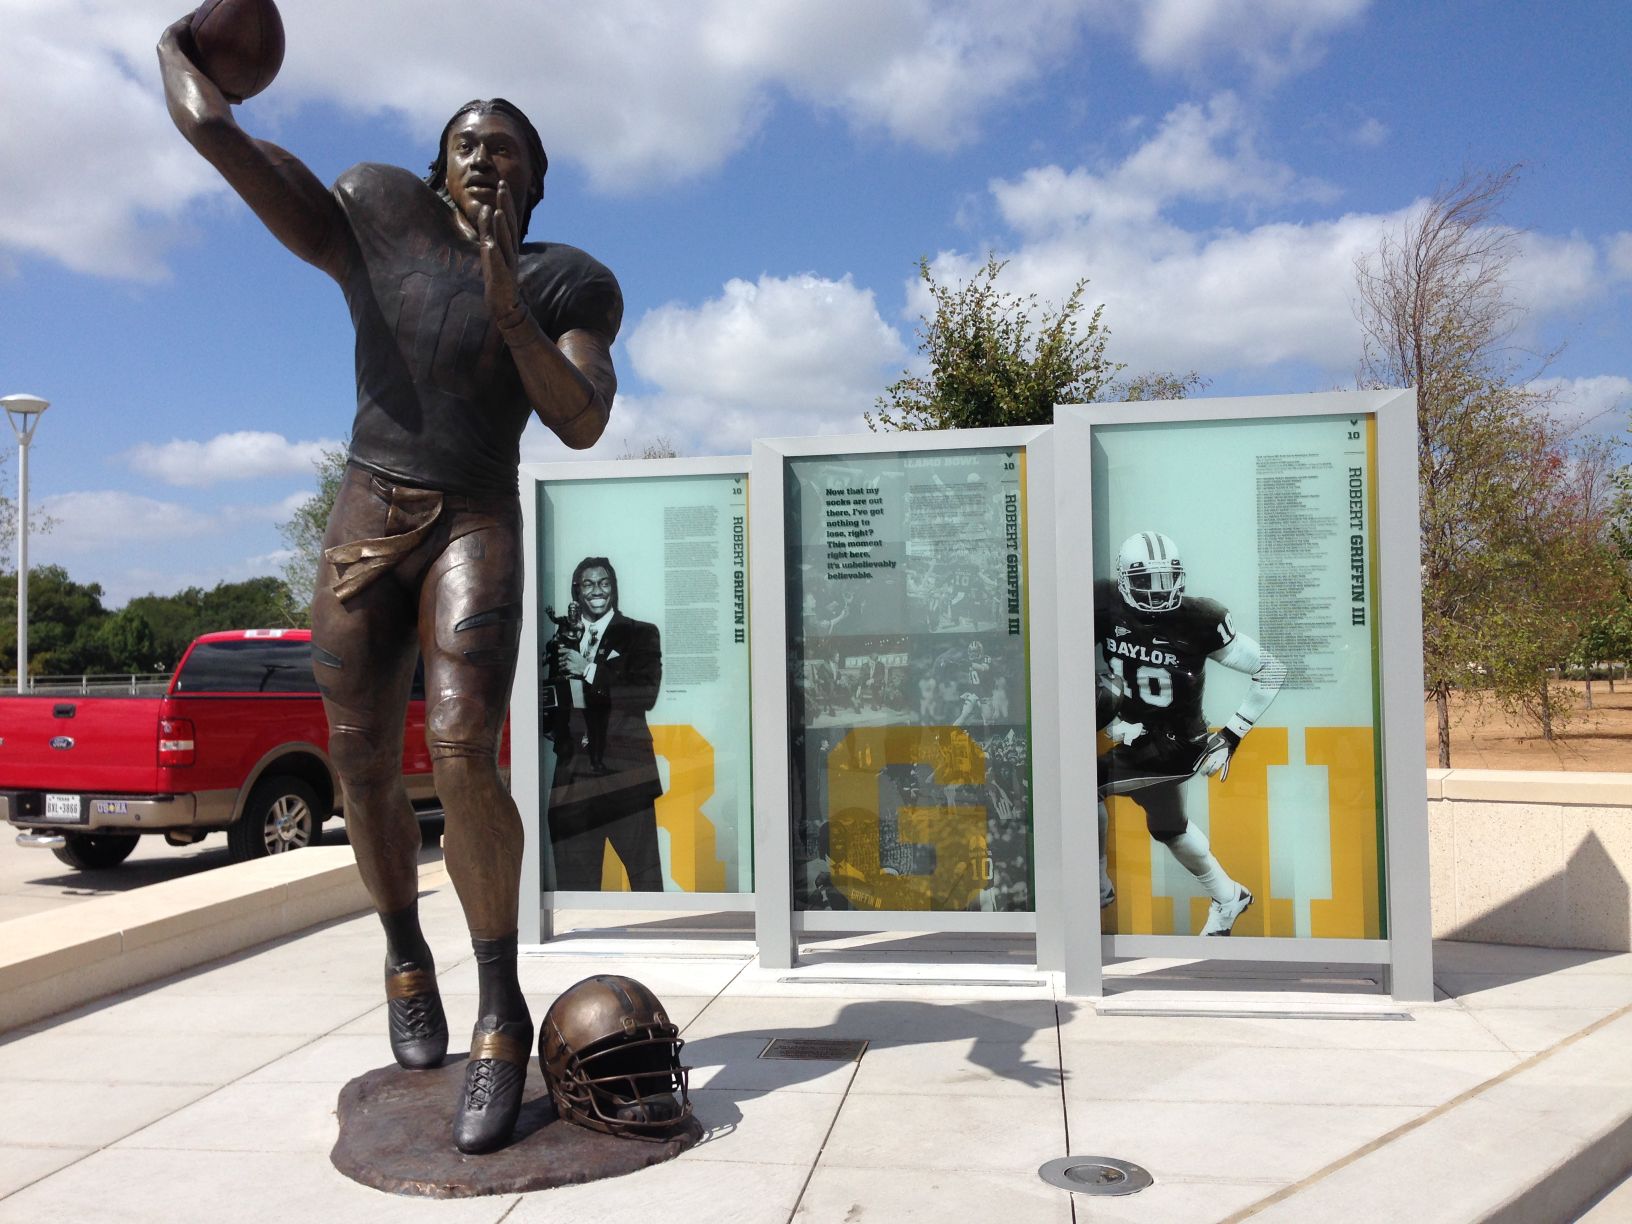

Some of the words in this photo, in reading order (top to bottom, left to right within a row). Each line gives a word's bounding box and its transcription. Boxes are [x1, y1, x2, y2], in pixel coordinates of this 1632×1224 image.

[1348, 431, 1360, 440] 10
[1003, 462, 1015, 470] 10
[825, 488, 845, 496] Now
[846, 487, 865, 495] that
[866, 487, 879, 495] my
[1349, 467, 1363, 531] ROBERT
[825, 498, 851, 506] socks
[868, 497, 883, 505] out
[826, 509, 851, 517] there,
[852, 508, 868, 516] I've
[869, 508, 884, 517] got
[826, 519, 859, 528] nothing
[1005, 494, 1018, 550] ROBERT
[826, 530, 847, 538] lose,
[847, 528, 874, 539] right?
[733, 516, 744, 567] ROBERT
[827, 540, 846, 548] This
[847, 539, 882, 548] moment
[827, 551, 848, 560] right
[841, 560, 897, 569] unbelievably
[1350, 534, 1365, 602] GRIFFIN
[827, 571, 873, 580] believable.
[1006, 553, 1020, 615] GRIFFIN
[734, 570, 745, 625] GRIFFIN
[1352, 606, 1365, 627] III
[1008, 617, 1020, 636] III
[734, 628, 745, 643] III
[1106, 638, 1179, 665] BAYLOR
[1109, 656, 1174, 708] 10
[970, 857, 994, 880] 10
